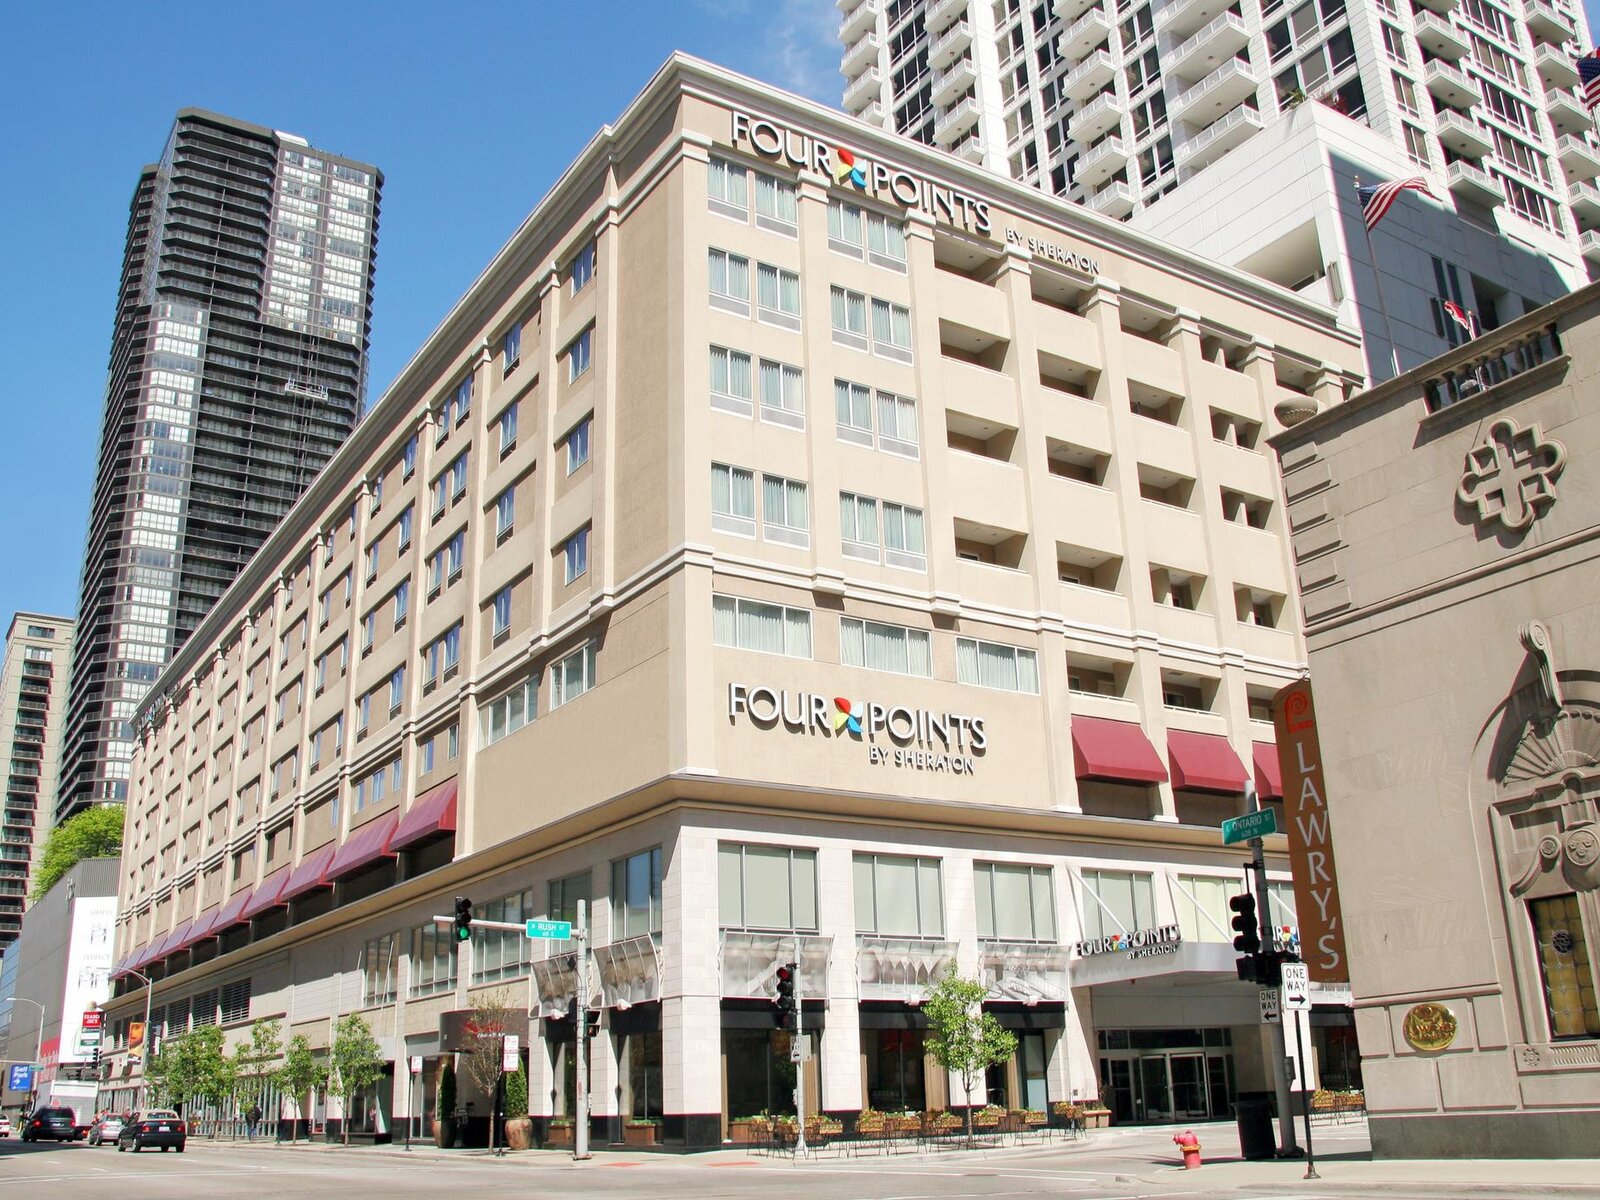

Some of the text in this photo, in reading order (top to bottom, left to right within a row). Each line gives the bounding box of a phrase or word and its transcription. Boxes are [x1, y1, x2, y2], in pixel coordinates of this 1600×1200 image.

[732, 111, 992, 234] FOUR POINTS
[1005, 227, 1100, 274] BY SHERATON
[728, 682, 988, 751] FOUR POINTS
[869, 746, 975, 775] BY SHERATON
[1232, 815, 1262, 832] ONTARIO
[1295, 741, 1340, 970] LAWRY'S
[537, 922, 557, 931] RUSH
[1076, 924, 1180, 956] FOUR POINTS
[1137, 943, 1177, 959] SHERATON
[1285, 968, 1305, 979] ONE
[1286, 981, 1306, 992] WAY
[1260, 990, 1276, 1001] ONE
[1261, 1001, 1277, 1011] WAY
